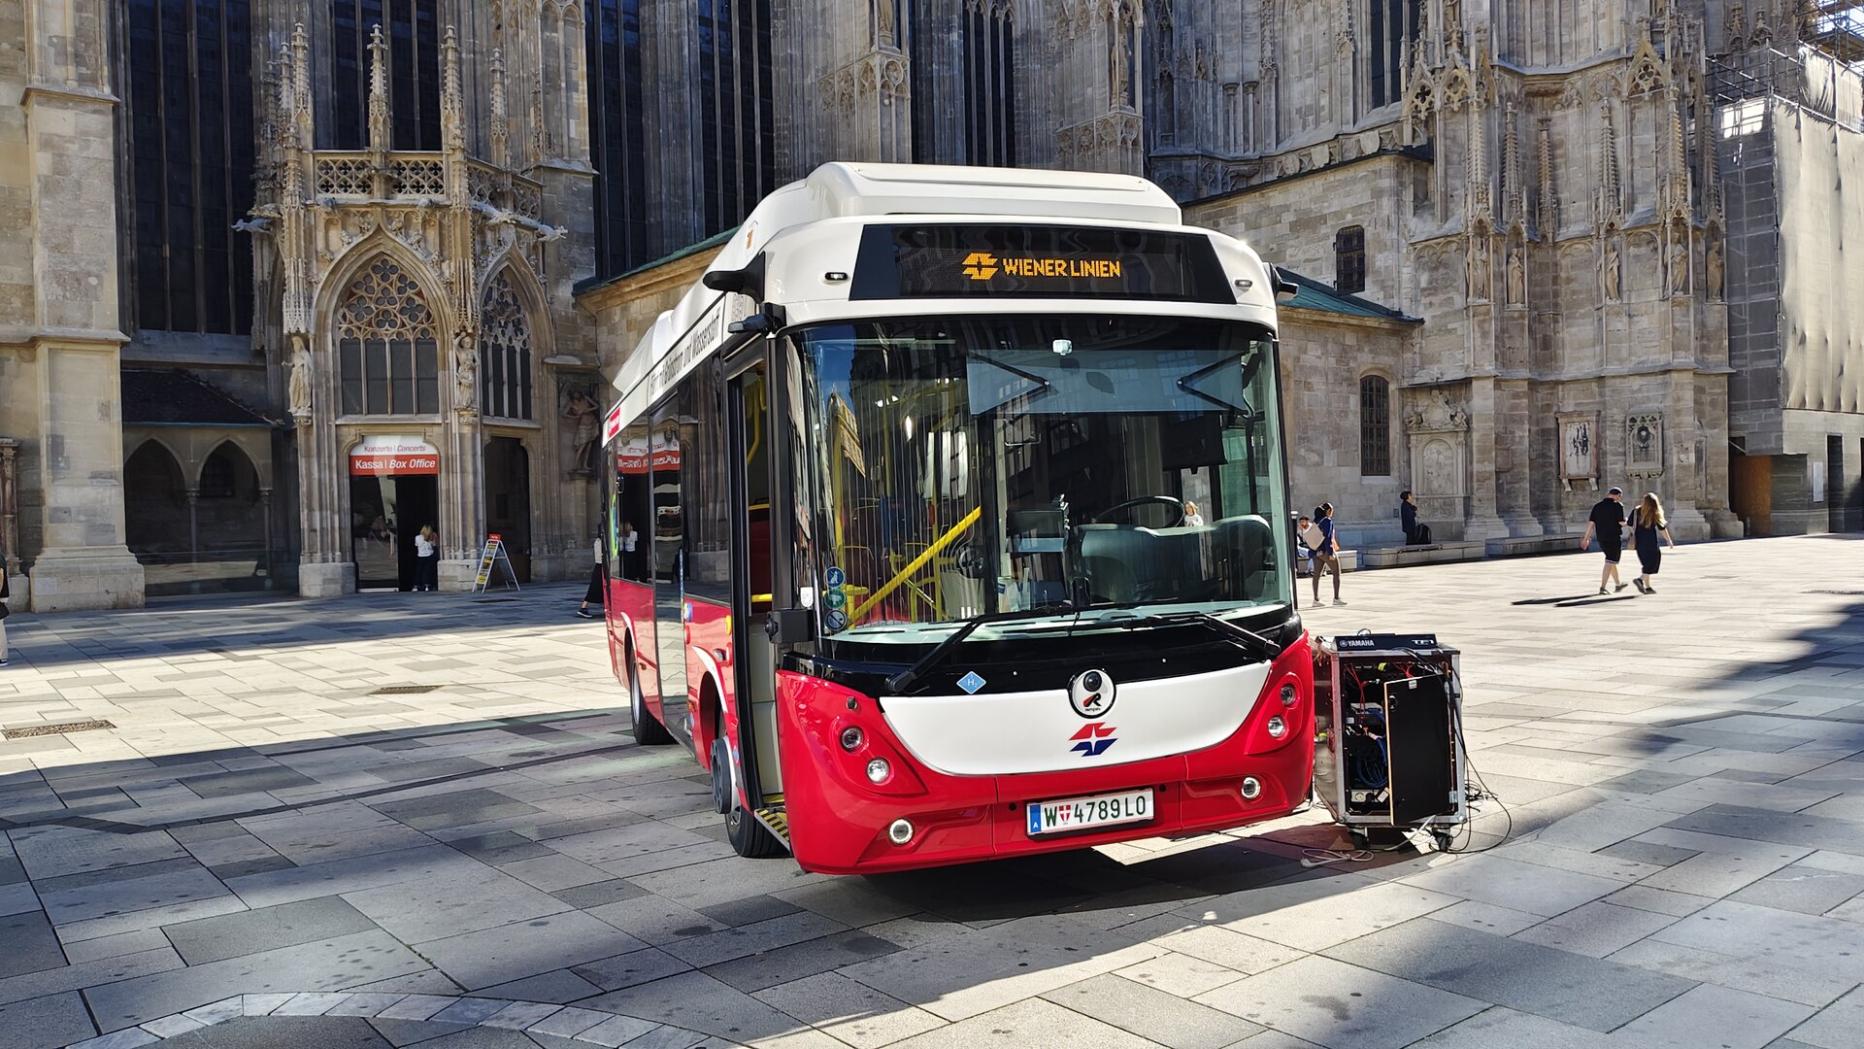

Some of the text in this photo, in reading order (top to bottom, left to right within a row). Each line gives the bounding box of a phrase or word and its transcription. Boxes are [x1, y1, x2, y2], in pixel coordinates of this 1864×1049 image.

[1002, 258, 1121, 278] WIENER LINIEN
[355, 458, 436, 469] Kassa Box Office
[1347, 639, 1375, 647] YAMAHA
